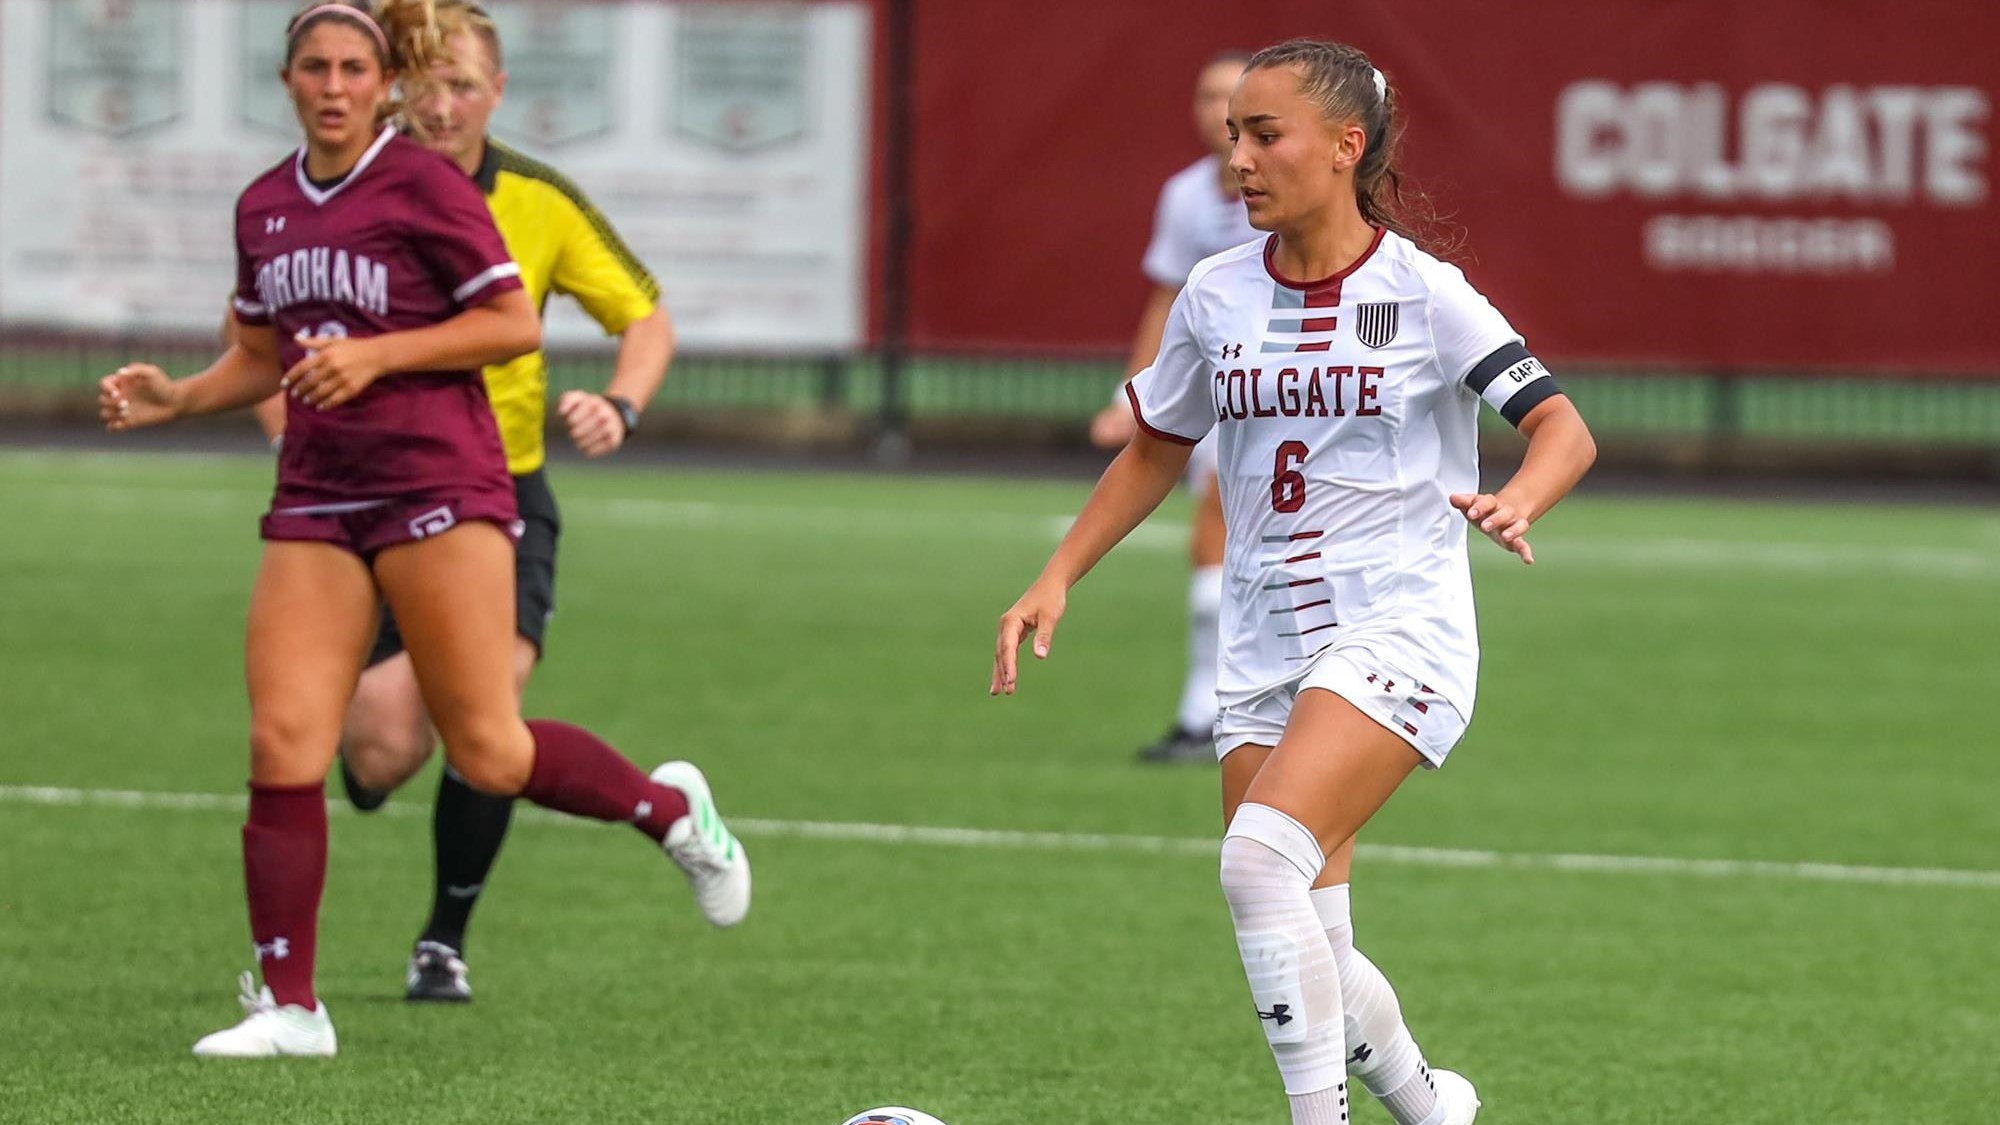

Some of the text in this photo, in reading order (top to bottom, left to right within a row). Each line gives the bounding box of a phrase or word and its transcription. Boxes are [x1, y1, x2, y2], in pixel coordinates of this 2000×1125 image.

[1556, 80, 1989, 206] COLGATE
[1643, 215, 1894, 275] SOCCER
[256, 246, 388, 317] ORDHAM
[1214, 366, 1385, 422] COLGATE
[1508, 360, 1544, 383] CAPT
[1270, 440, 1310, 513] 6
